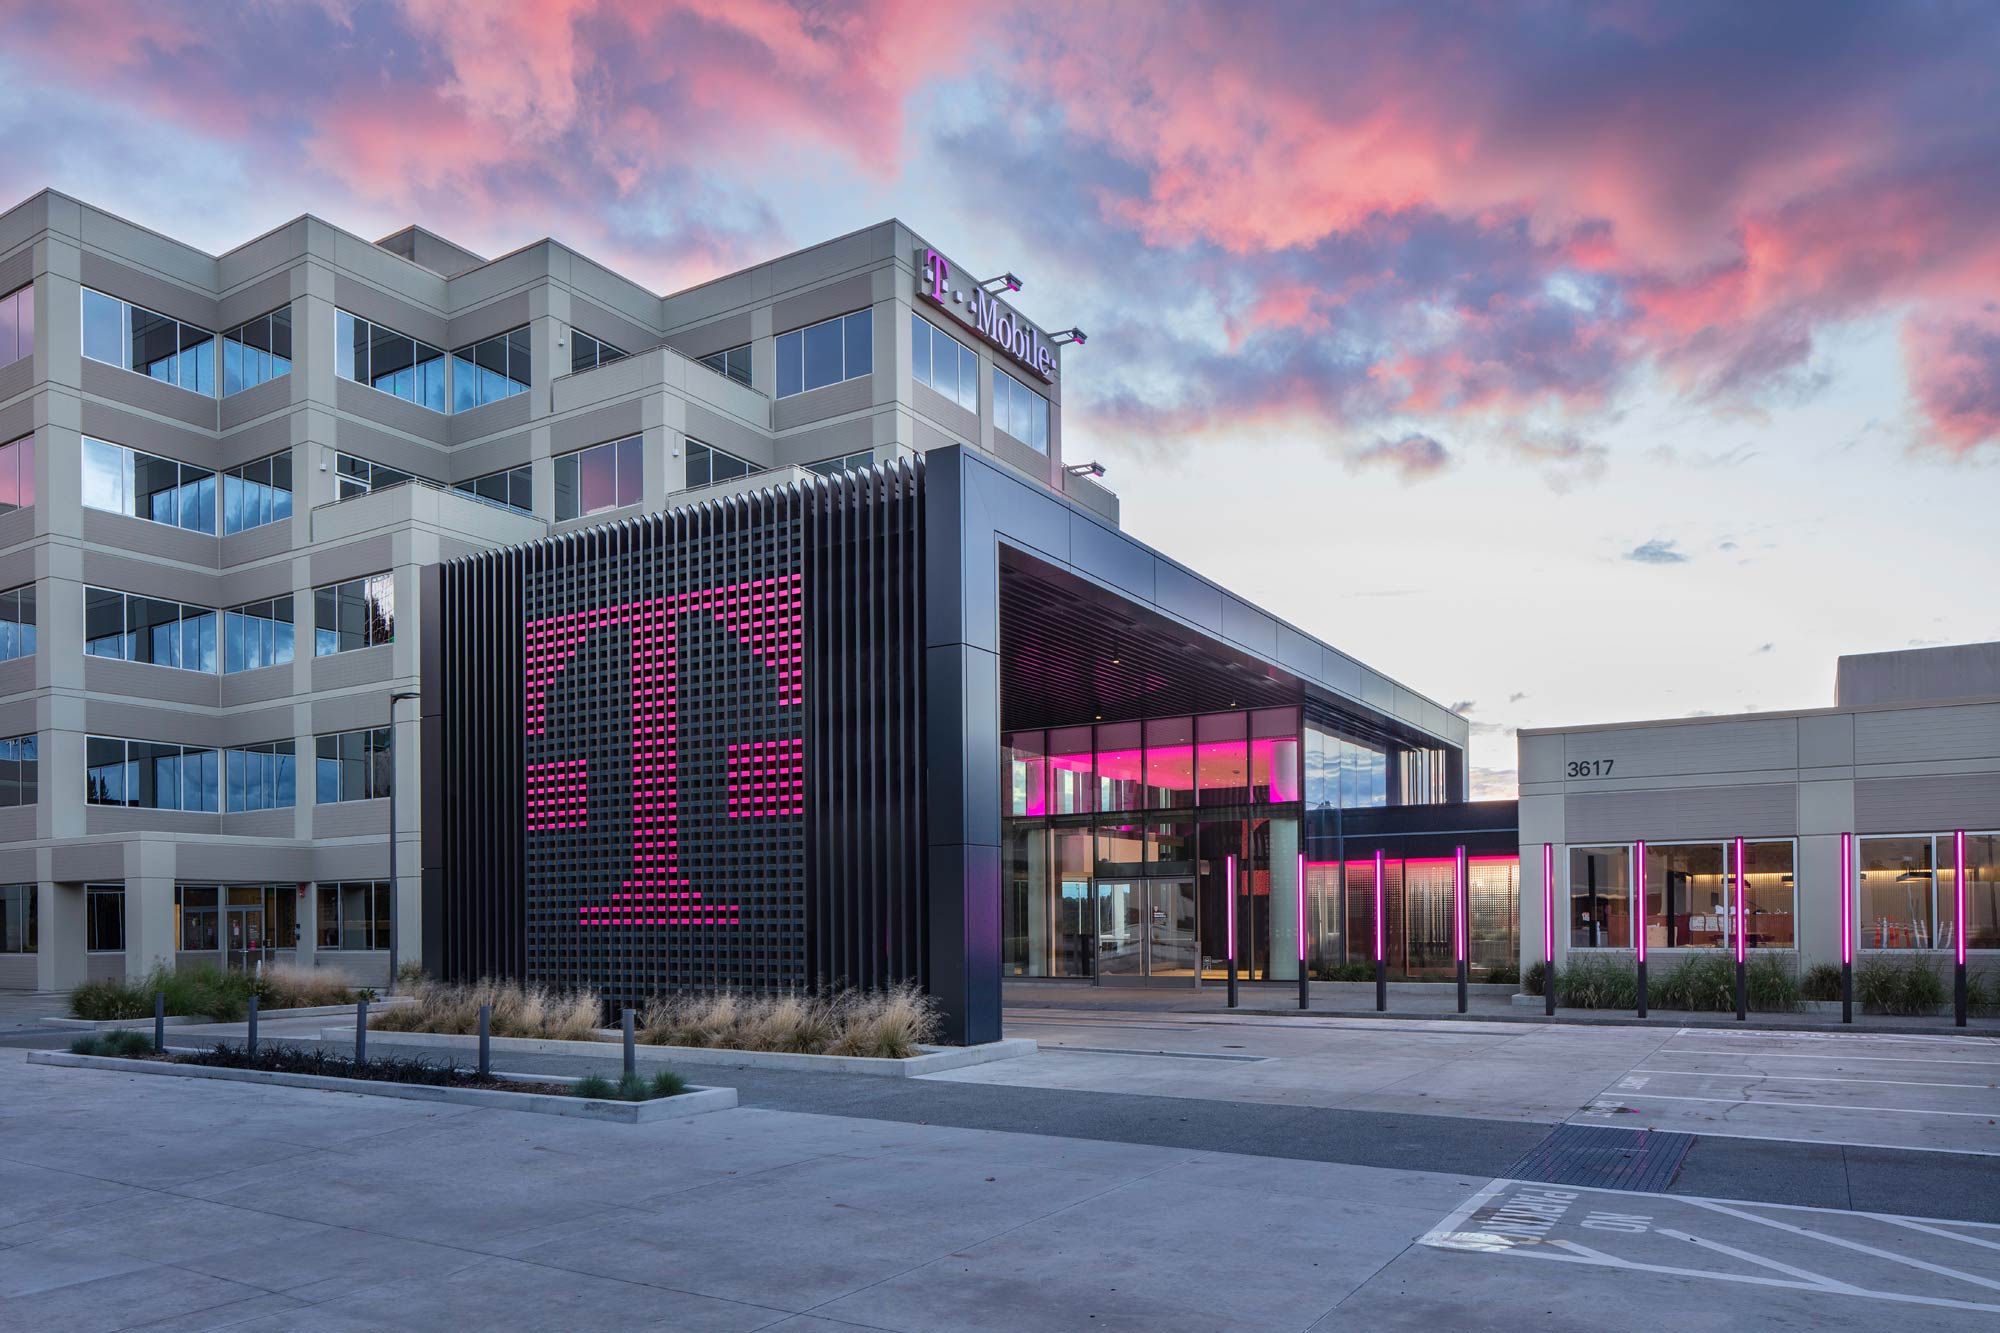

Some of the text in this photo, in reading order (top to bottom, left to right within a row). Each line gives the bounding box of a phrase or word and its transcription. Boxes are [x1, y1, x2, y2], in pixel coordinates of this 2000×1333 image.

[525, 573, 802, 925] T
[1567, 759, 1614, 778] 3617
[1580, 1210, 1654, 1233] NO
